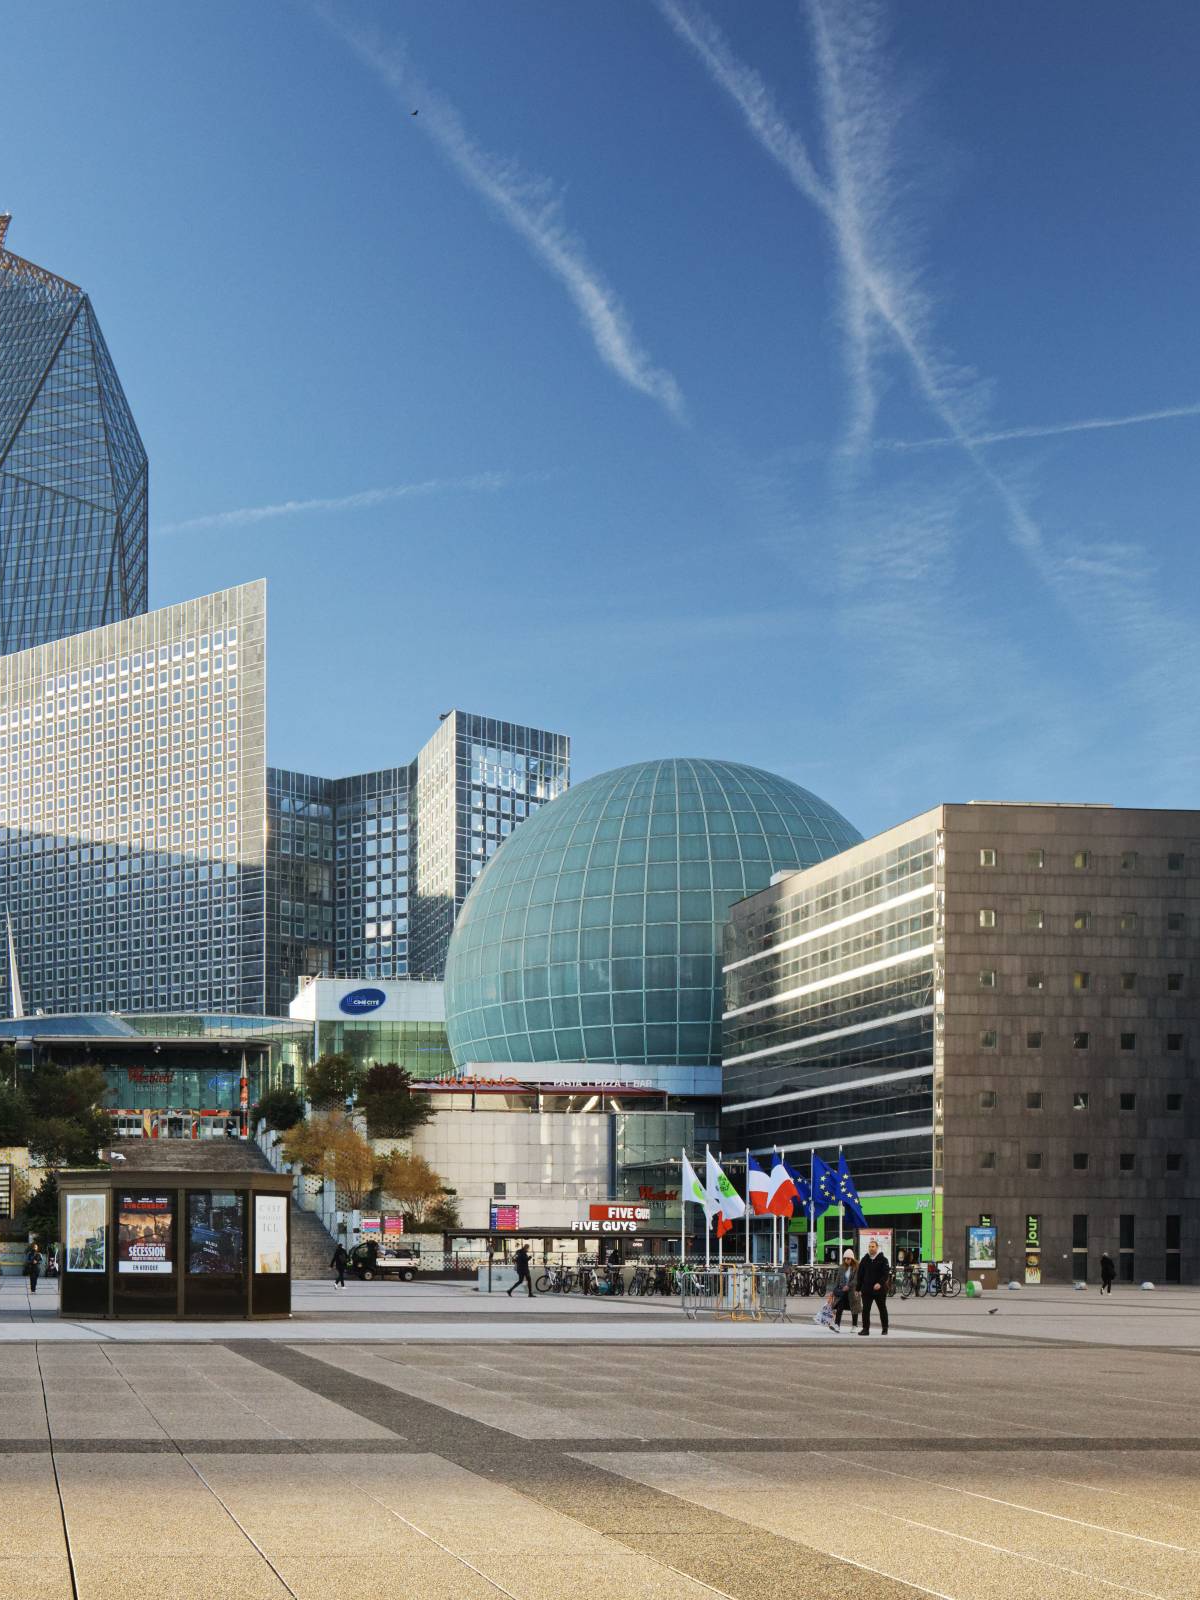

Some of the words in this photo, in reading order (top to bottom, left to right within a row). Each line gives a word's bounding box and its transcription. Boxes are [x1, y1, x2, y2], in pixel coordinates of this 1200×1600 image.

[608, 1207, 634, 1219] FIVE
[571, 1221, 600, 1231] FIVE
[602, 1221, 637, 1231] GUYS
[1026, 1216, 1039, 1246] jour
[128, 1245, 166, 1257] SÉCESSION
